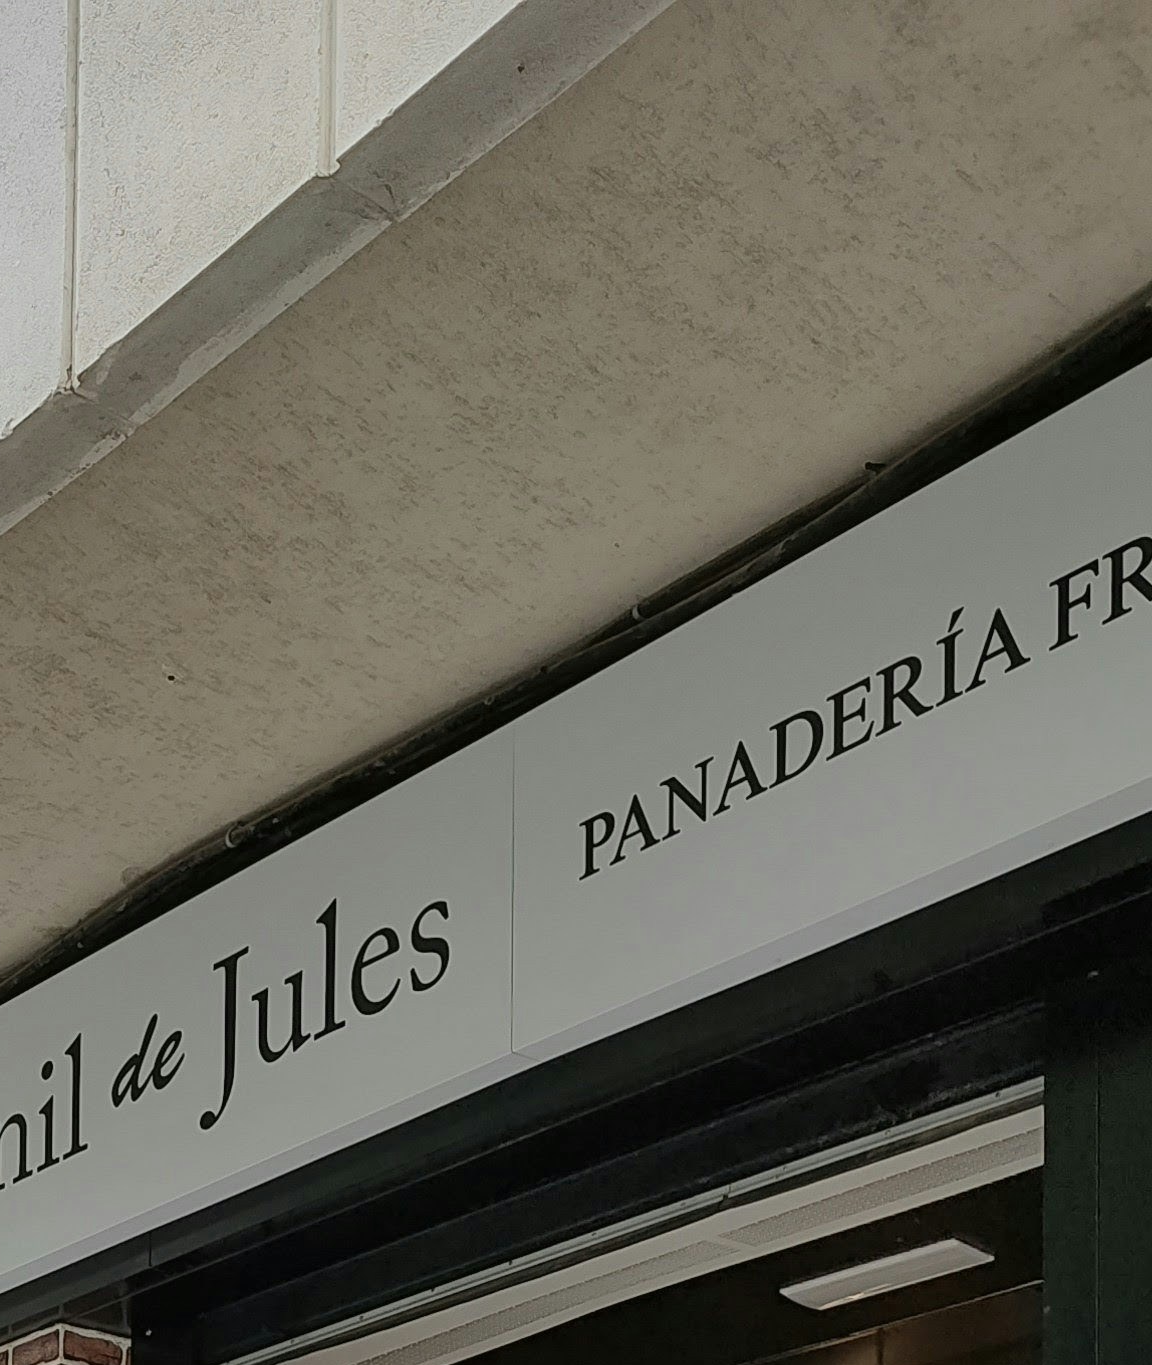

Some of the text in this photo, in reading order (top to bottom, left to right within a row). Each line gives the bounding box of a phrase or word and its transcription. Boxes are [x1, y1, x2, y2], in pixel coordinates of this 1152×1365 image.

[579, 536, 1152, 880] PANADERÍA FR
[112, 1013, 184, 1107] de
[199, 898, 450, 1130] Jules
